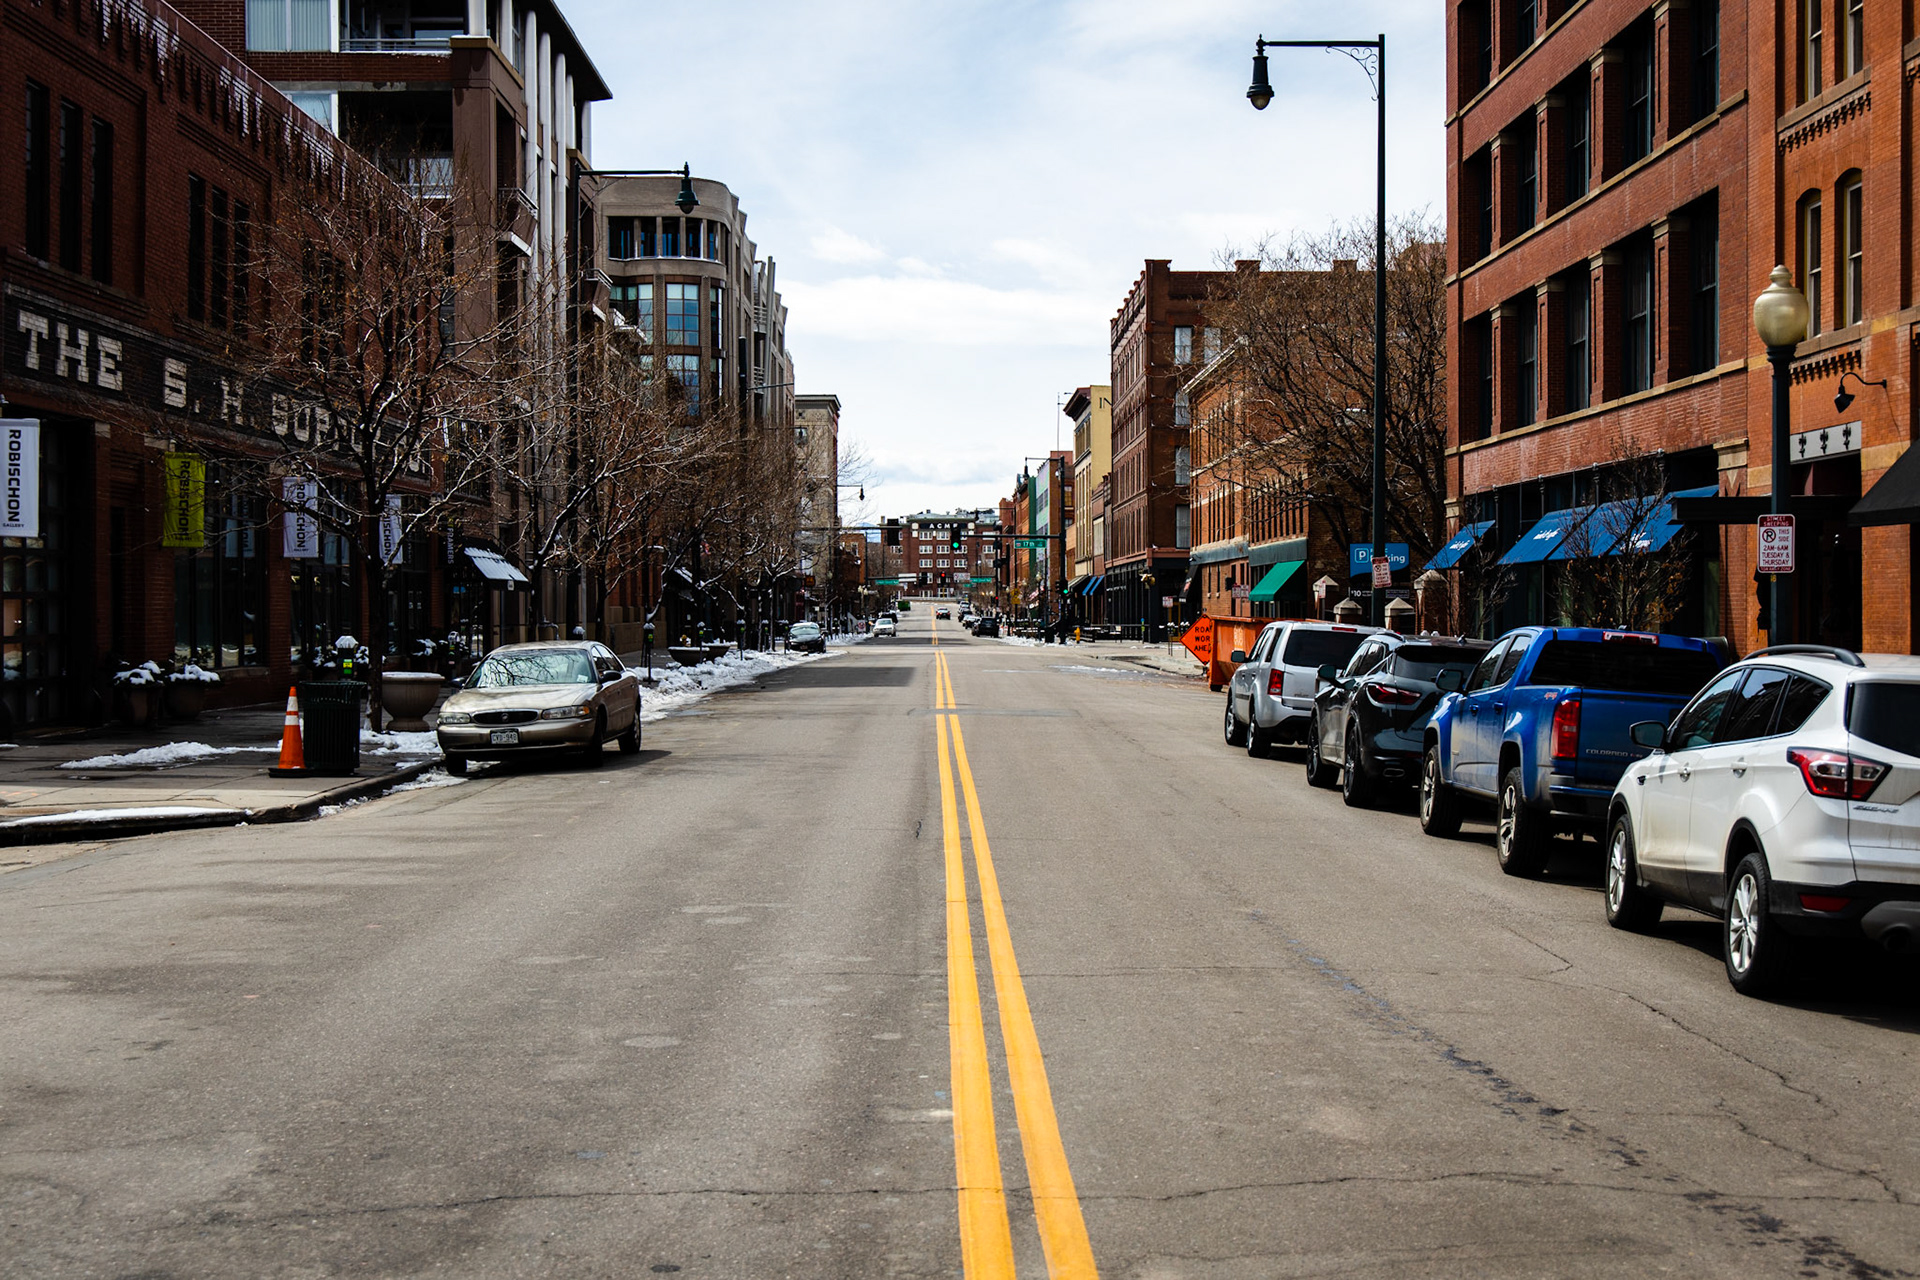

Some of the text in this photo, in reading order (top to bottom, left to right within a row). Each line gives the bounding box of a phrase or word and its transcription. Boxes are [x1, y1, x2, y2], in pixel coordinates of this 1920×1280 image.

[17, 309, 123, 391] THE
[8, 429, 21, 522] ROBISCHON
[178, 460, 190, 536] ROBISCHON
[297, 484, 306, 548] ROCHON
[1586, 749, 1628, 757] COLORADO
